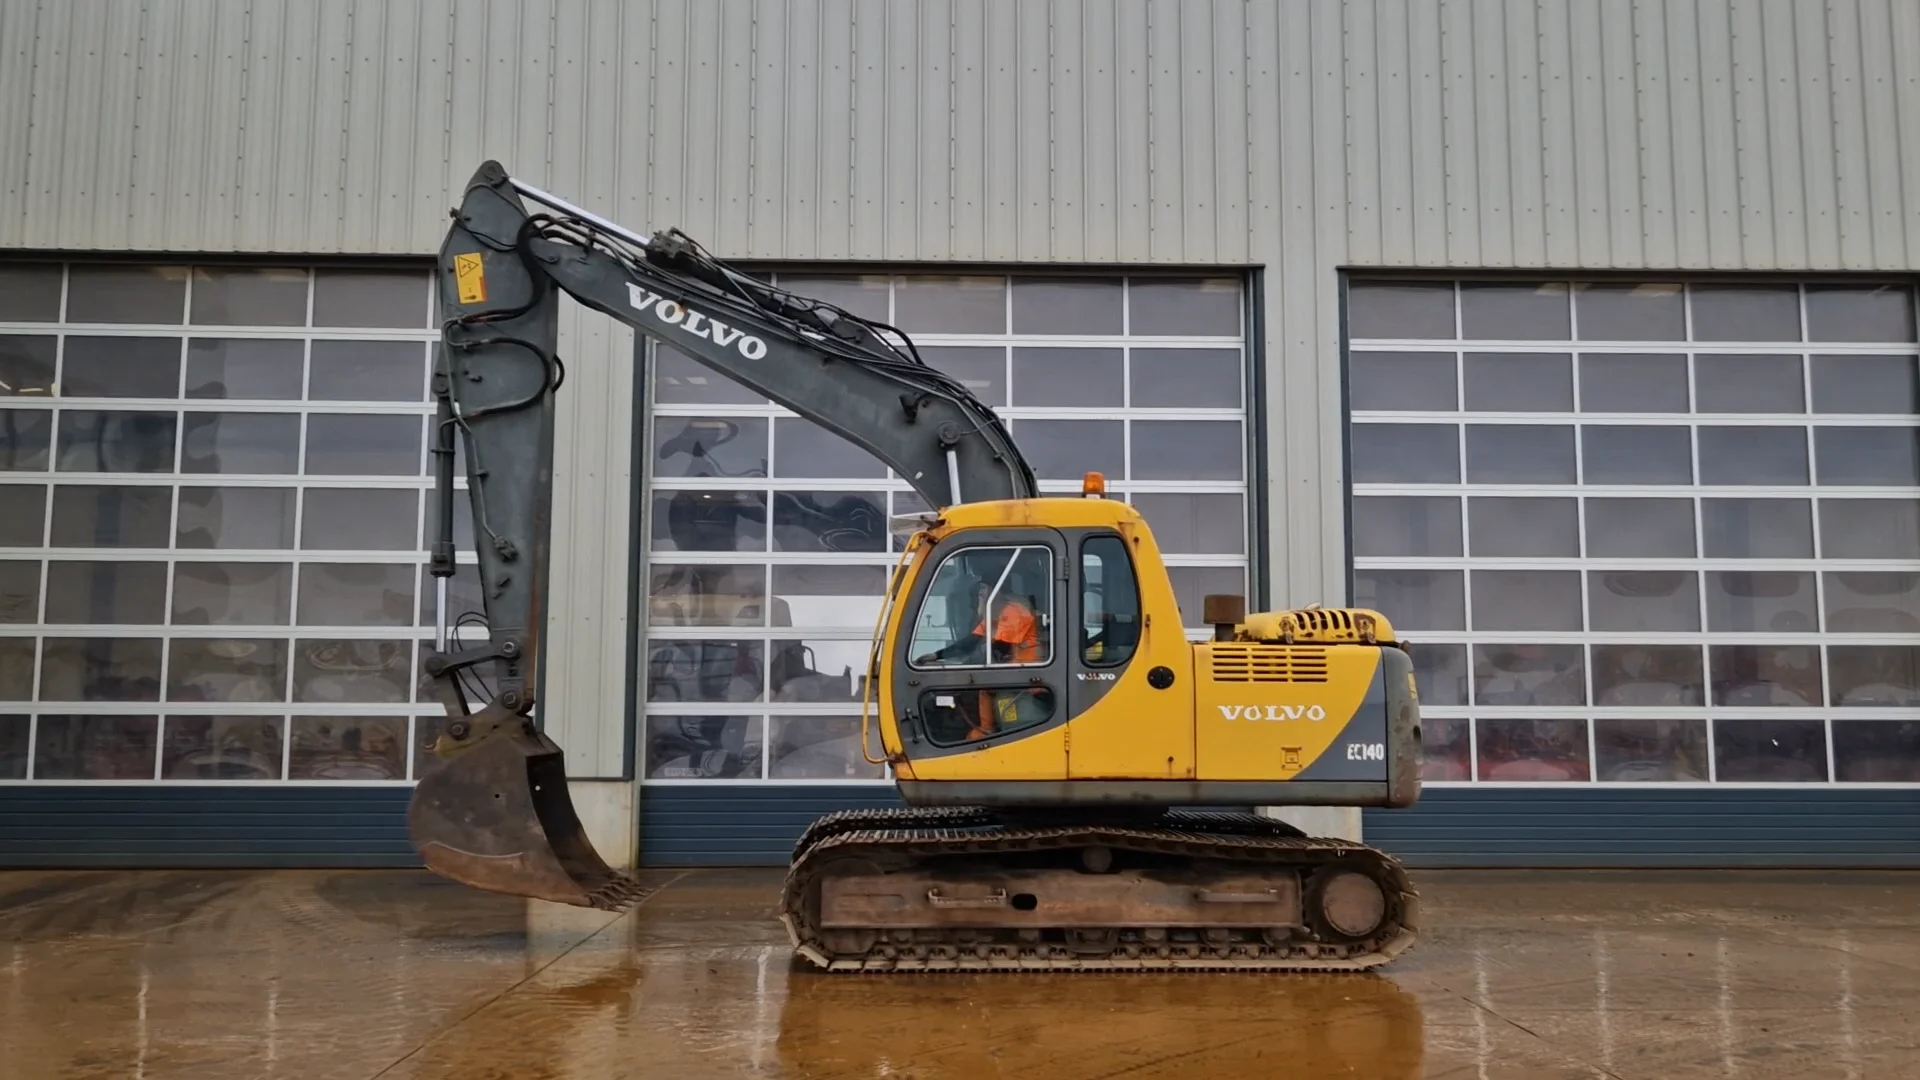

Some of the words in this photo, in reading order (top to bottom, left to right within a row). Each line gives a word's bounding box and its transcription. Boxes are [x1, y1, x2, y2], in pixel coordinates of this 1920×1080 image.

[625, 282, 768, 360] VOLVO
[1217, 705, 1326, 721] VOLVO
[1347, 743, 1385, 760] EC140
